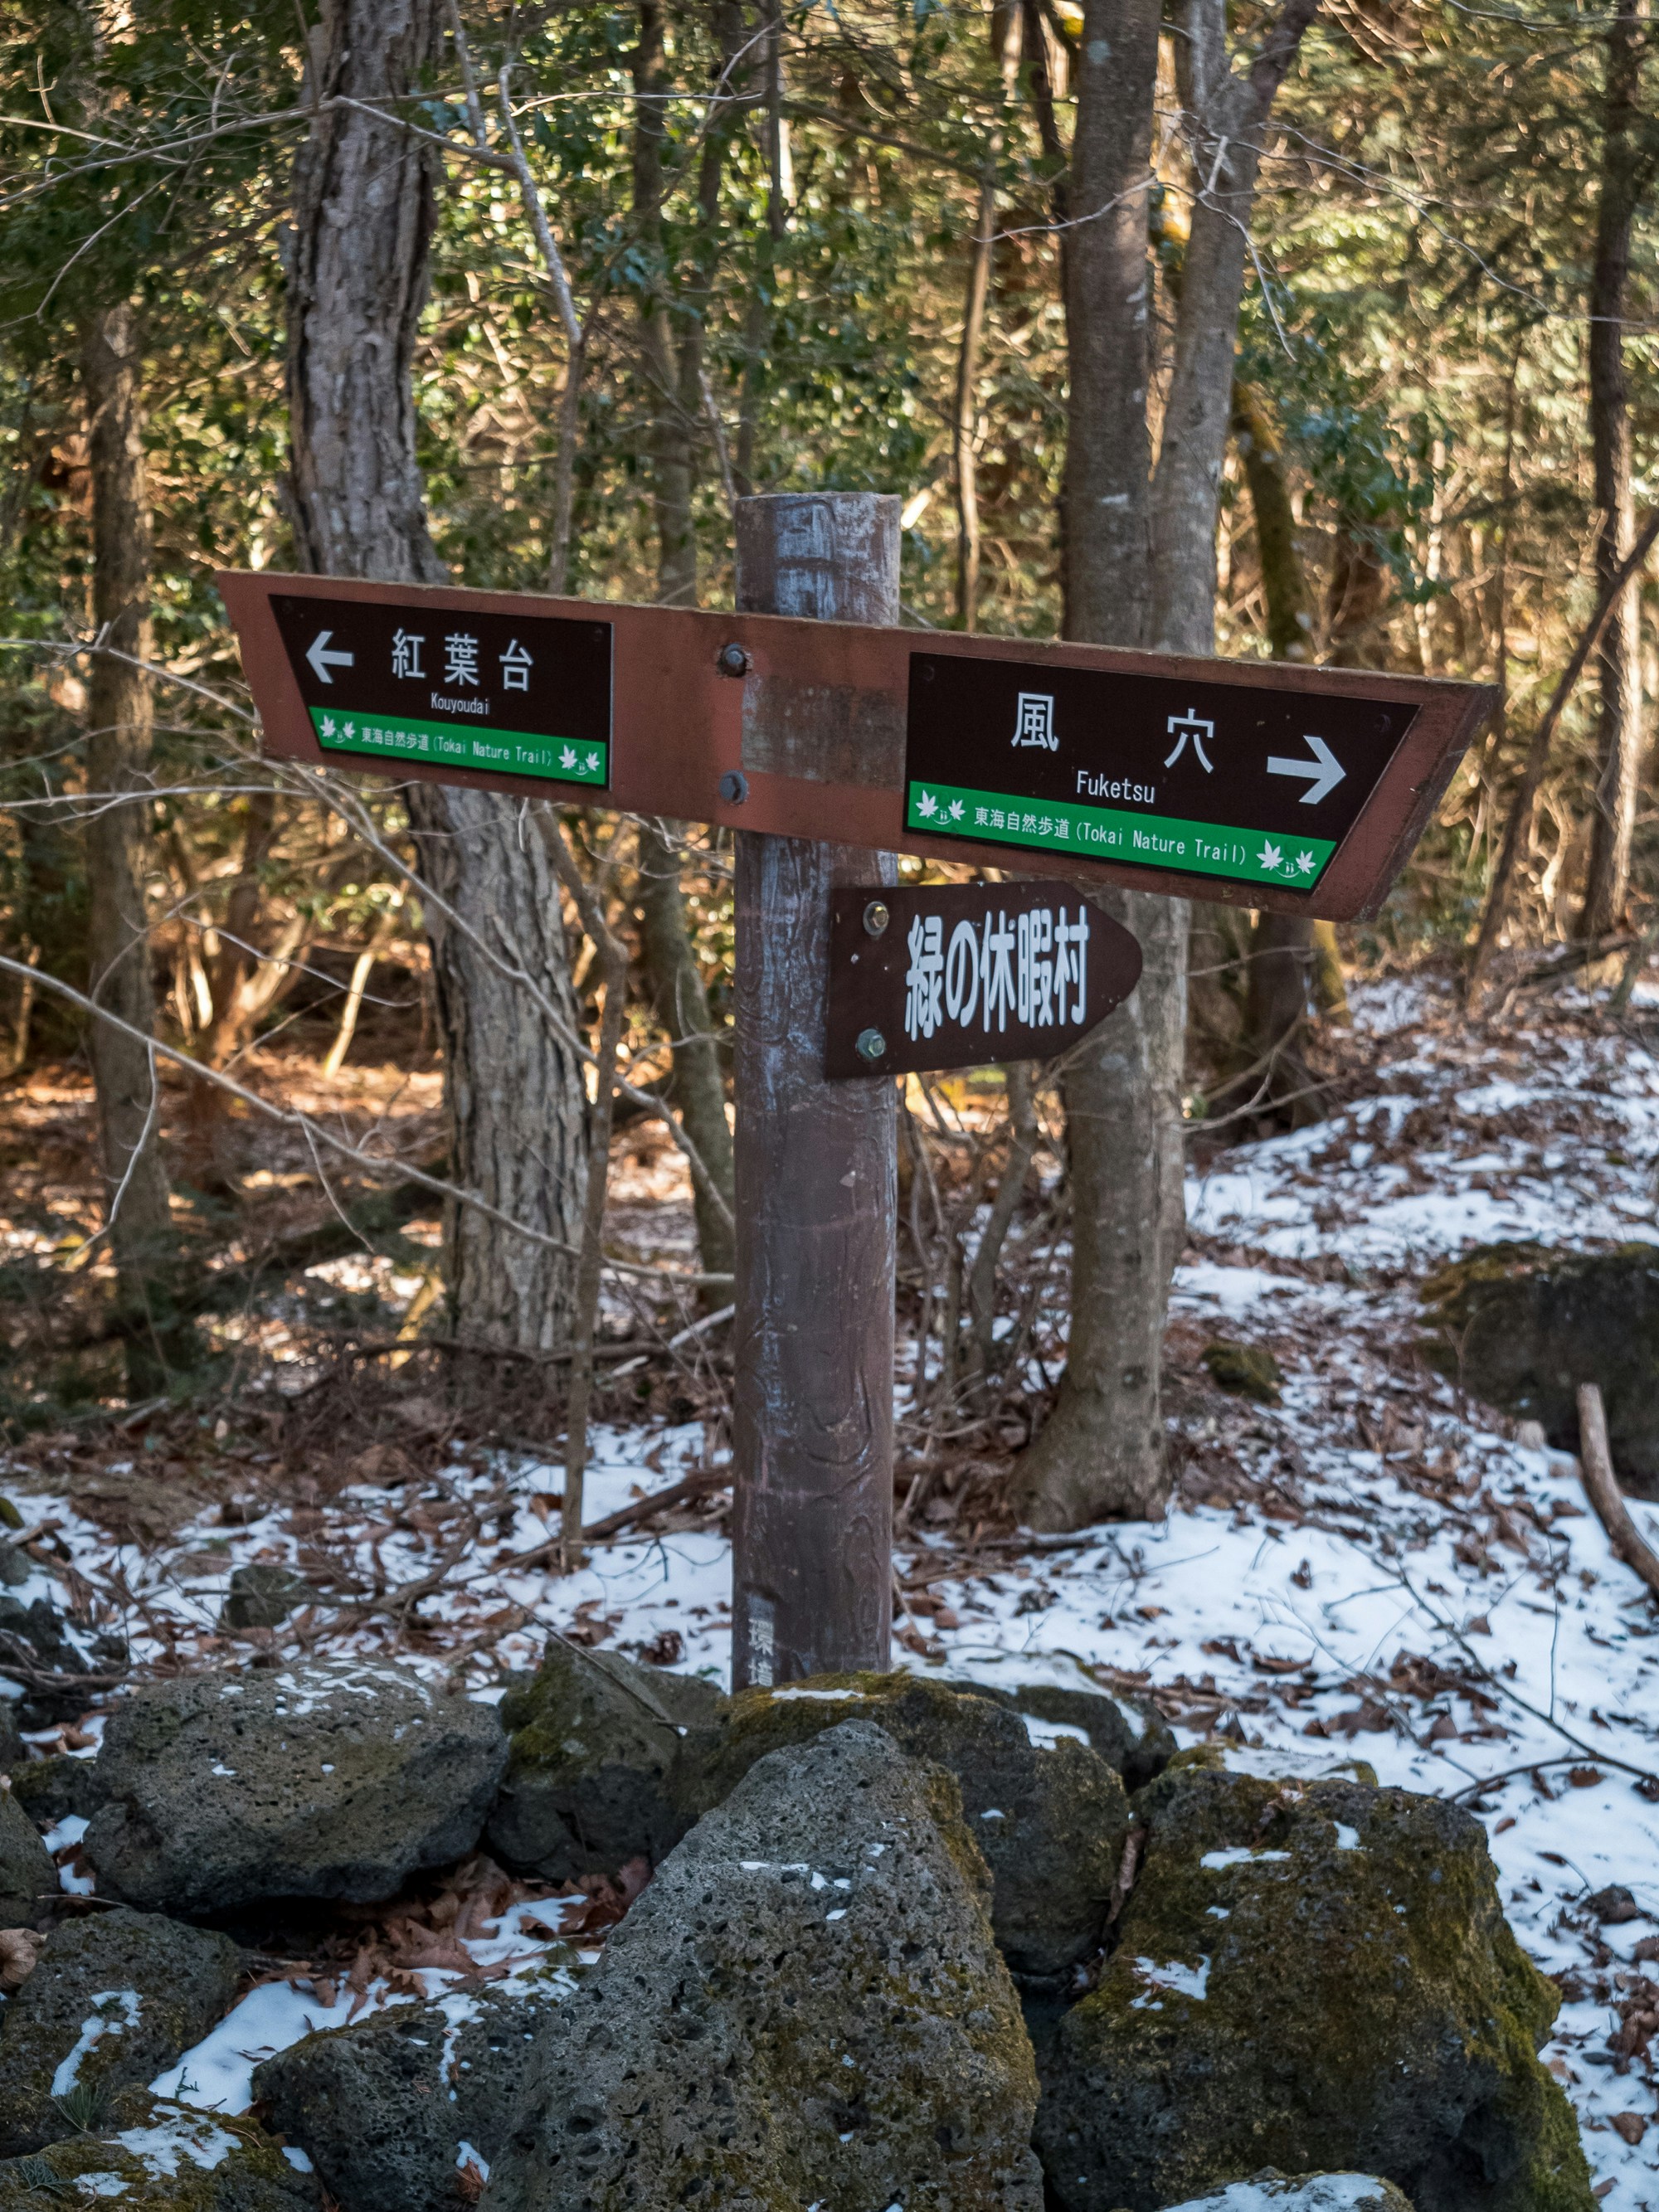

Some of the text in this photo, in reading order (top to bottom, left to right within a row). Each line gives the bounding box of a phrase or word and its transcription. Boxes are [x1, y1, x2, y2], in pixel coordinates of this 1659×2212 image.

[391, 628, 533, 692] 紅葉台
[431, 692, 490, 716] Kouyoudai
[361, 727, 552, 766] 東海自然歩道 (Tokai Nature Trail)
[1076, 770, 1156, 805] Fuketsu
[973, 806, 1246, 865] 東海自然歩道 (Tokai Nature Trail)
[905, 904, 1091, 1042] 緑の休暇村
